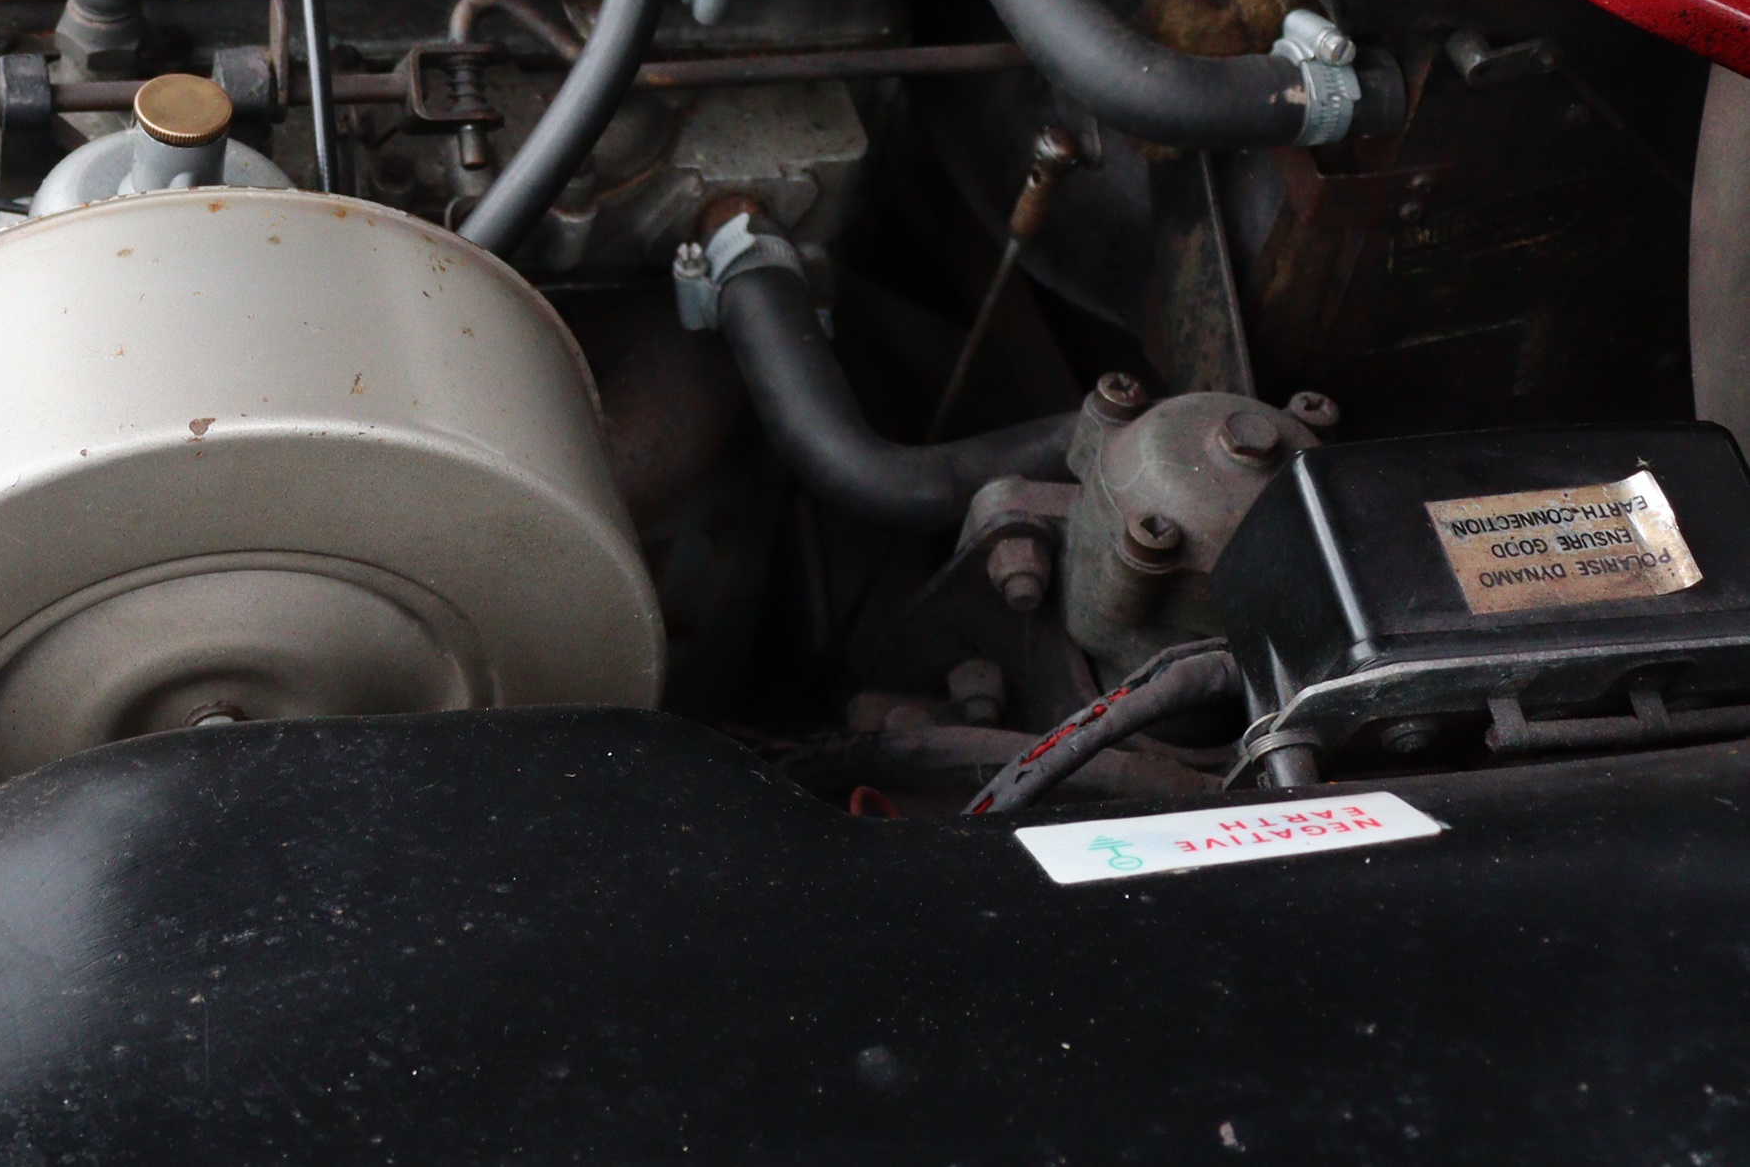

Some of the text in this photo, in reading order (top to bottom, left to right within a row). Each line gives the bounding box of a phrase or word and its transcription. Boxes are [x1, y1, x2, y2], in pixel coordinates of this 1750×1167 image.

[1490, 527, 1632, 559] ENSURE GOOD
[1478, 547, 1672, 589] POLARISE DYNAMO
[1173, 817, 1383, 853] NEGATIVE
[1217, 805, 1367, 832] EARTH
